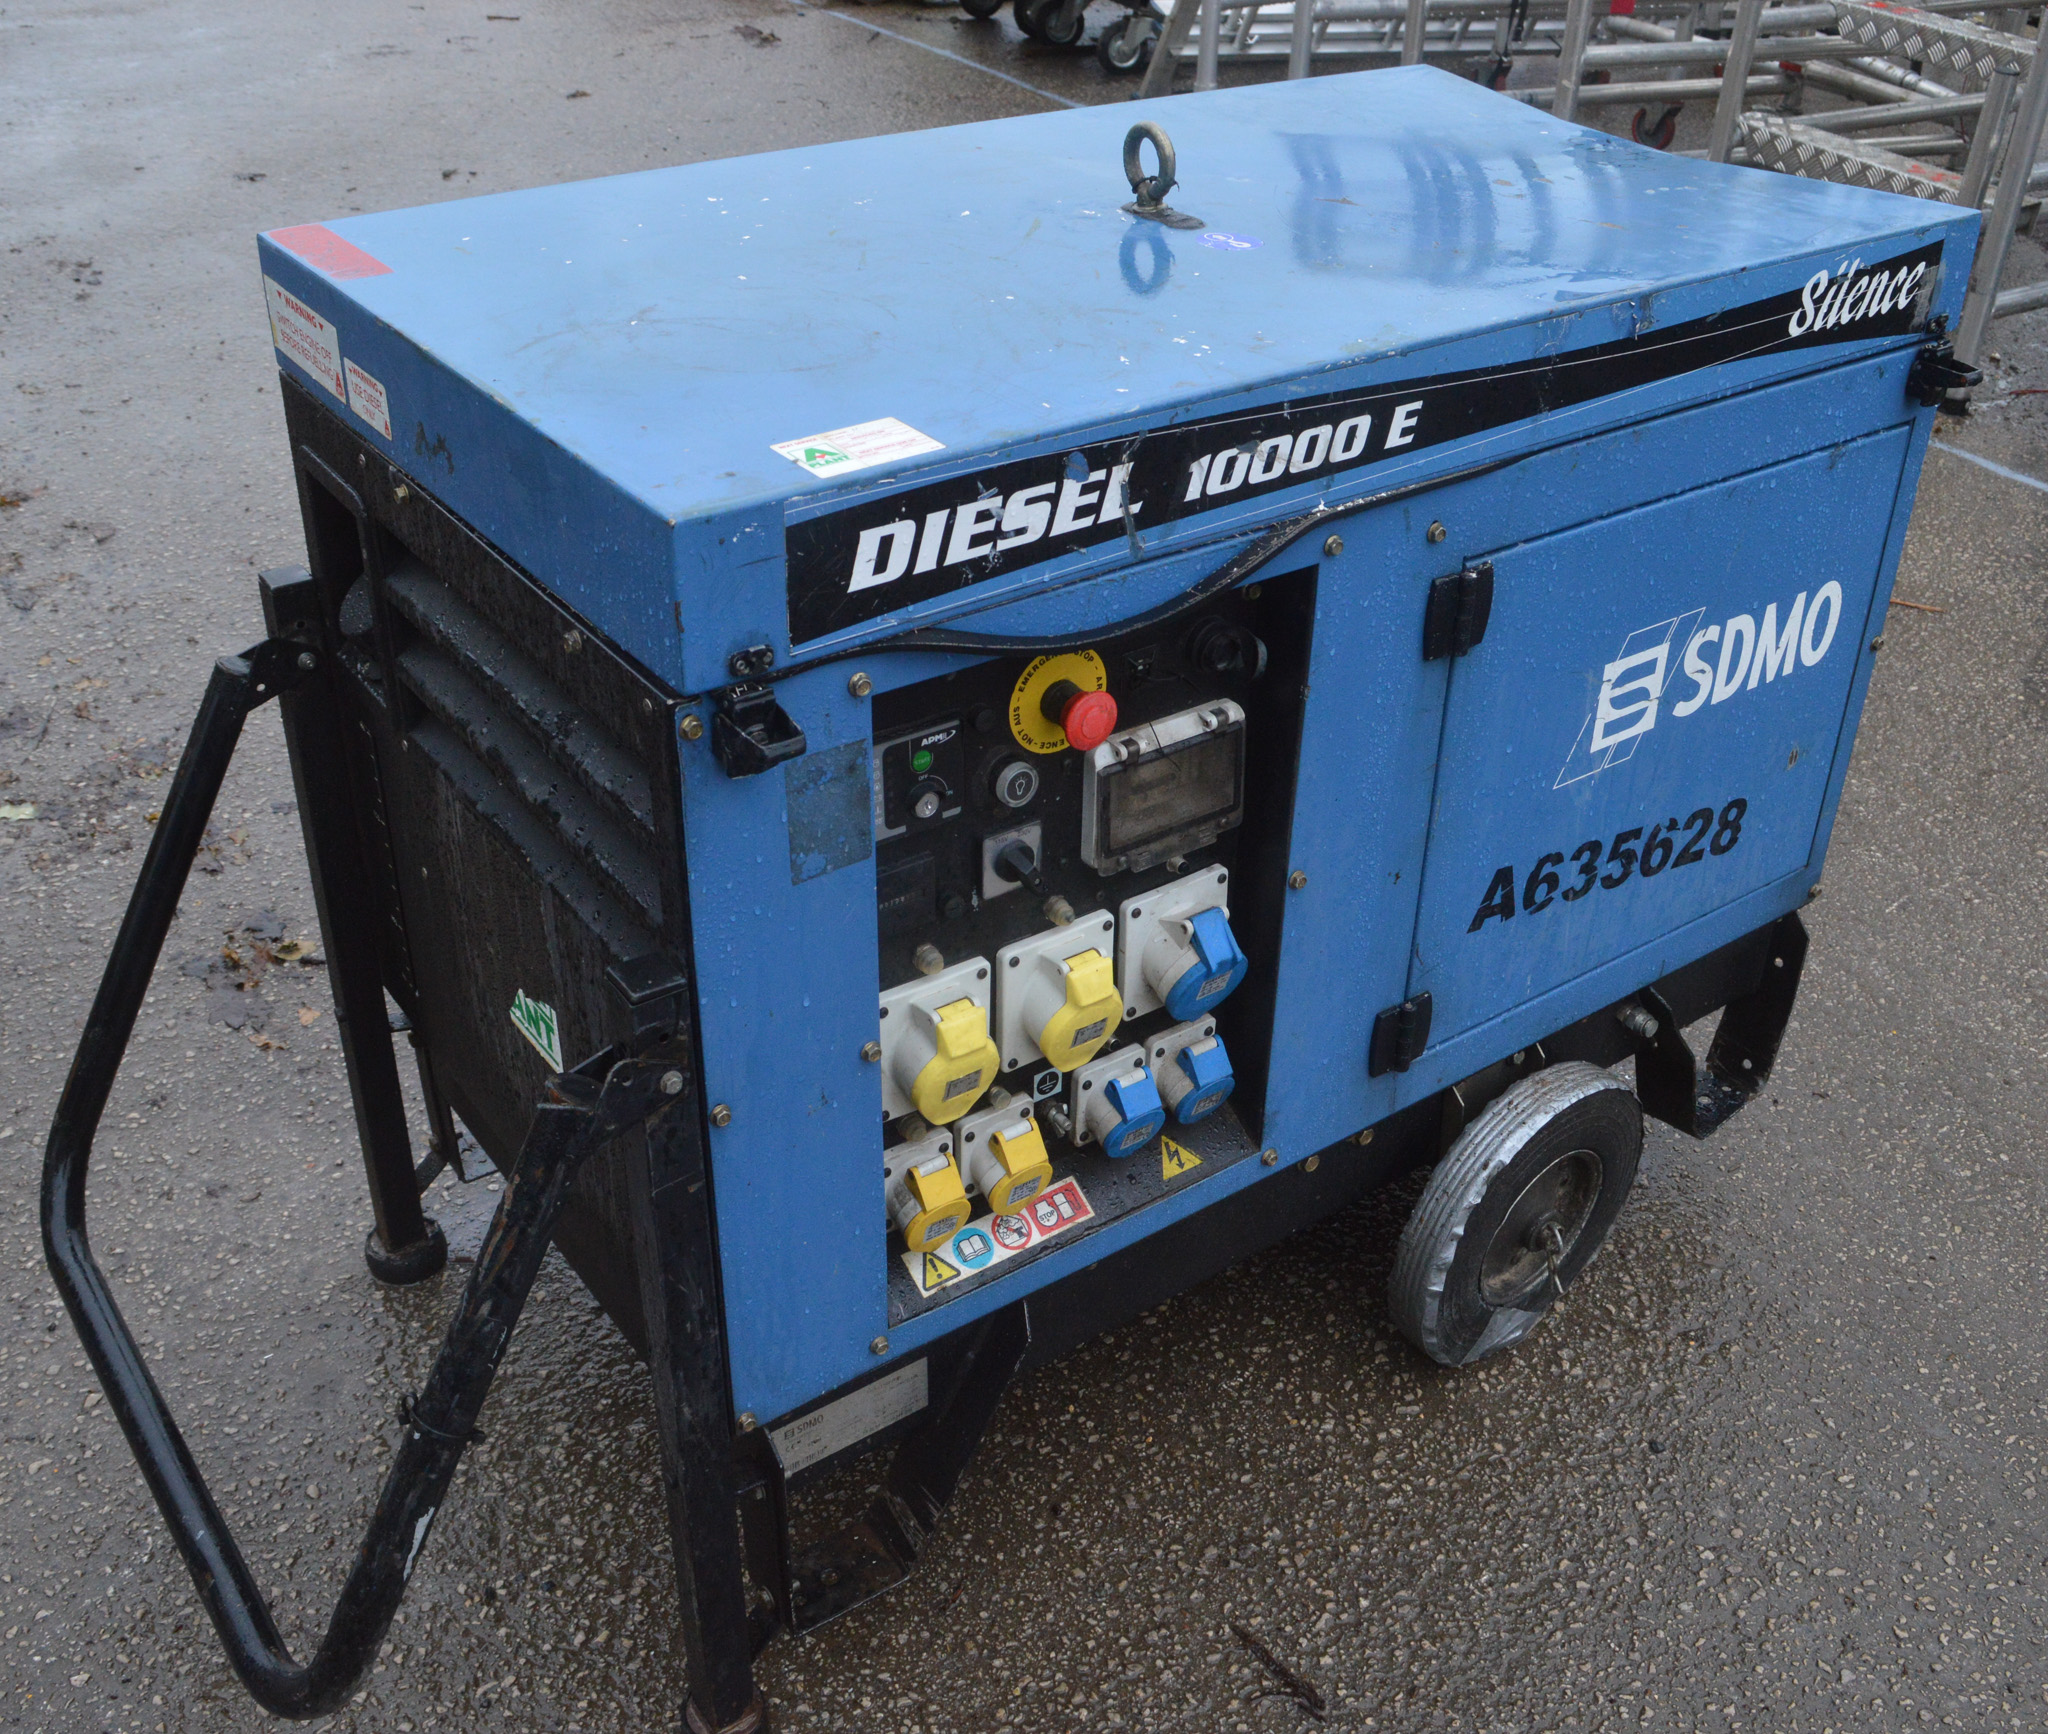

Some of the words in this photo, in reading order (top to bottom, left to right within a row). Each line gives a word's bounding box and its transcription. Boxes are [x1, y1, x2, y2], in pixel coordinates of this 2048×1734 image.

[1788, 257, 1926, 338] Silence
[284, 295, 317, 328] WARNING
[351, 365, 378, 392] WARNING
[807, 455, 851, 468] PLANT
[847, 462, 1143, 593] DIESEL
[1183, 415, 1372, 502] 10000
[1383, 400, 1423, 450] E
[1672, 580, 1842, 718] SDMO
[1013, 705, 1021, 726] AUS
[1017, 728, 1034, 746] NOT
[1467, 798, 1747, 934] A635628
[1039, 1209, 1055, 1221] STOP
[797, 1415, 824, 1433] SDMO
